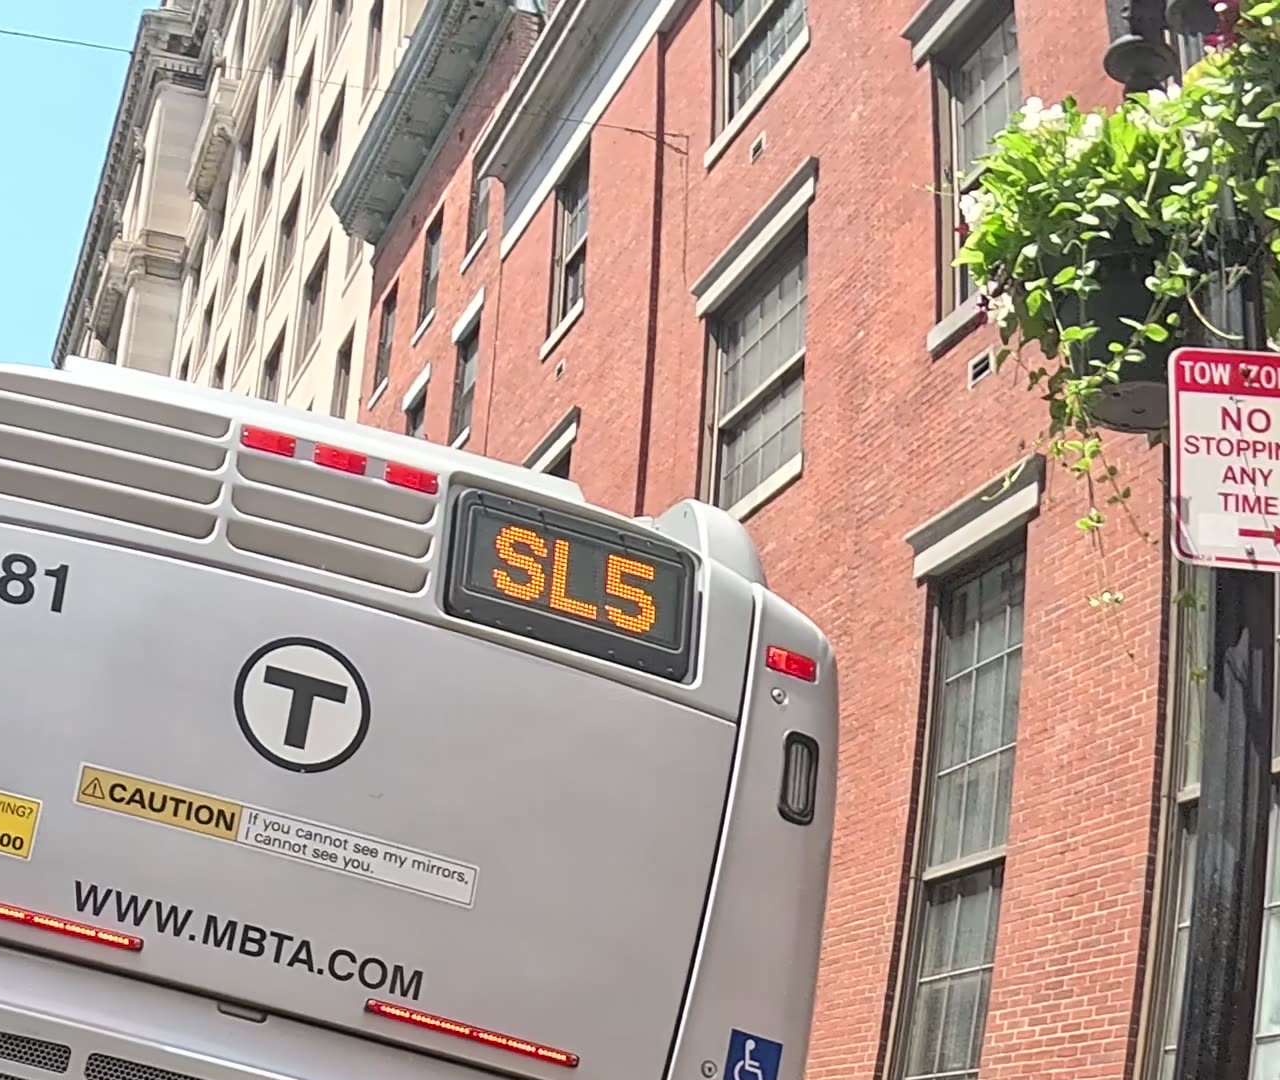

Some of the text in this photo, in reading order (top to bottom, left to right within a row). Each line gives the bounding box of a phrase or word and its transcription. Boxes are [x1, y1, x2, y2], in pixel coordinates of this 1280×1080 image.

[1179, 361, 1280, 389] TOW ZO
[1220, 406, 1272, 433] NO
[1222, 465, 1273, 486] ANY
[1218, 492, 1279, 516] TIME
[492, 524, 657, 634] SL5
[108, 782, 235, 832] CAUTION
[244, 827, 374, 874] I cannot see you.
[248, 812, 469, 885] If you cannot see my mirrors.
[73, 880, 425, 1002] WWW.MBTA.COM
